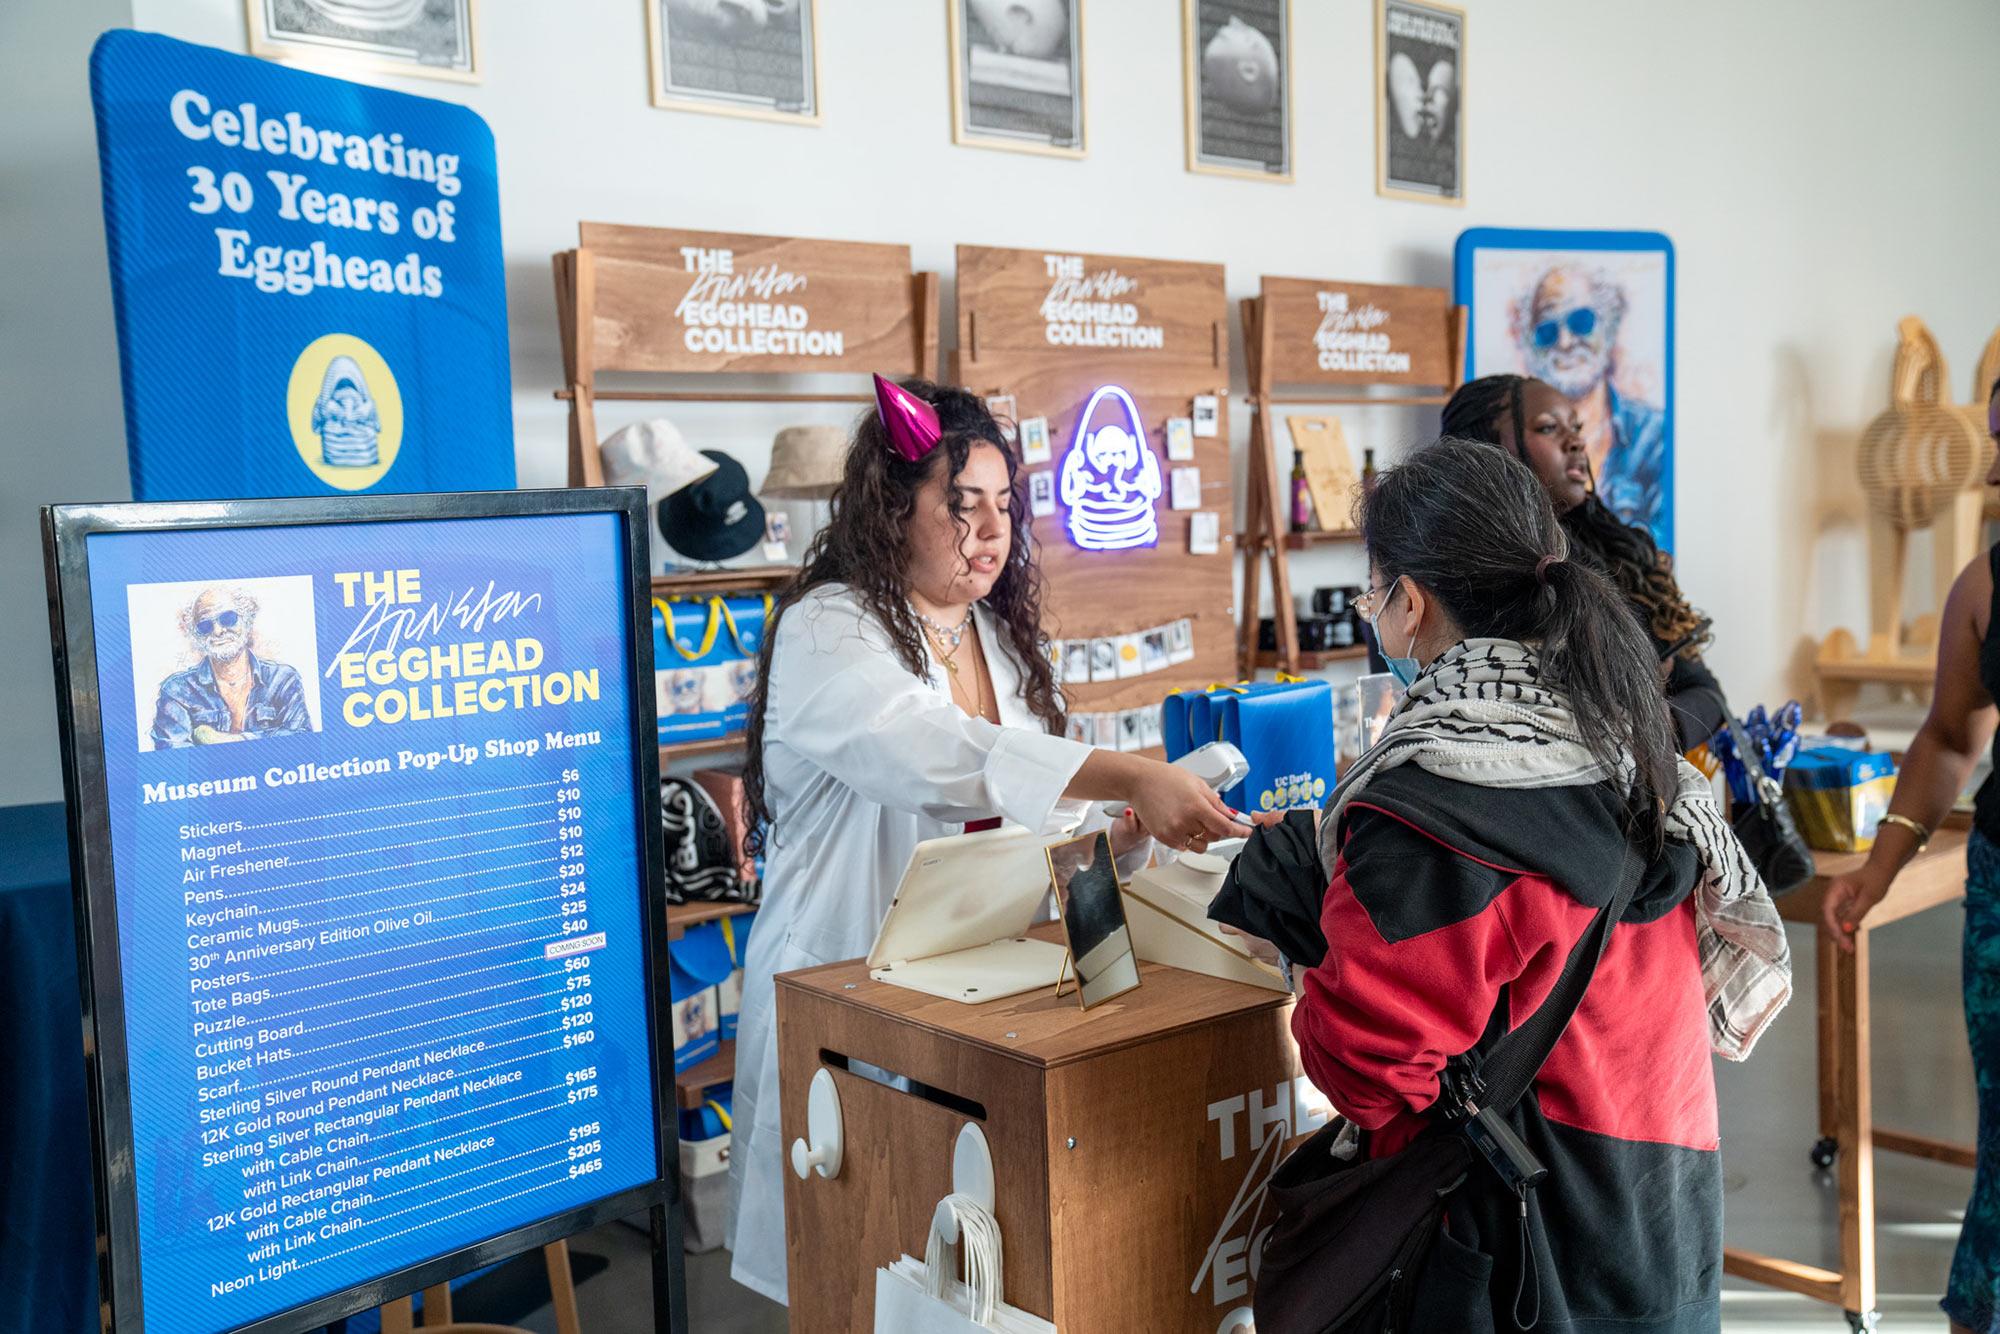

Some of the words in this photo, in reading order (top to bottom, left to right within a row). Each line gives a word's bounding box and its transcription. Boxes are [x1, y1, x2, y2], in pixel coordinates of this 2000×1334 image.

[170, 89, 461, 196] Celebrating
[187, 167, 253, 213] 30
[268, 171, 399, 235] Years
[412, 200, 456, 242] of
[214, 228, 442, 298] Eggheads
[680, 247, 733, 275] THE
[1044, 255, 1084, 277] THE
[683, 304, 807, 331] EGGHEAD
[685, 328, 842, 356] COLLECTION
[1045, 303, 1138, 324] EGGHEAD
[1046, 324, 1162, 348] COLLECTION
[334, 569, 421, 607] THE
[340, 638, 544, 688] EGGHEAD
[343, 669, 600, 727] COLLECTION
[142, 775, 257, 804] Museum
[264, 757, 391, 787] Collection
[397, 743, 478, 770] Pop-Up
[485, 739, 539, 758] Shop
[545, 730, 601, 750] Menu
[179, 821, 242, 839] Stickers
[562, 769, 579, 783] $6
[181, 840, 242, 861] Magnet
[557, 787, 580, 803] $10
[183, 869, 205, 883] Air
[210, 856, 289, 879] Freshener
[558, 806, 581, 822] $10
[184, 889, 223, 905] Pens
[559, 825, 582, 841] $10
[186, 905, 258, 927] Keychain
[560, 844, 583, 860] $12
[187, 927, 253, 949] Ceramic
[258, 919, 299, 935] Mugs
[559, 862, 585, 879] $20
[225, 936, 315, 964] Anniversary
[320, 926, 369, 944] Edition
[374, 918, 409, 933] Olive
[413, 911, 432, 926] Oil
[560, 881, 586, 898] $24
[191, 971, 250, 993] Posters
[561, 899, 587, 916] $25
[191, 998, 226, 1014] Tote
[231, 988, 270, 1006] Bags
[562, 918, 588, 935] $40
[193, 1015, 246, 1037] Puzzle
[549, 942, 580, 955] COMING
[582, 936, 604, 948] SOON
[195, 1036, 253, 1058] Cutting
[258, 1021, 303, 1043] Board
[564, 956, 590, 973] $60
[196, 1055, 252, 1080] Bucket
[256, 1048, 291, 1065] Hats
[566, 973, 591, 991] $75
[198, 1079, 239, 1102] Scarf
[560, 992, 592, 1012] $120
[199, 1099, 260, 1124] Sterling
[265, 1086, 307, 1106] Silver
[311, 1070, 358, 1094] Round
[362, 1055, 420, 1081] Pendant
[424, 1041, 485, 1065] Necklace
[561, 1011, 593, 1030] $120
[200, 1125, 229, 1145] 12K
[234, 1114, 271, 1136] Gold
[276, 1100, 324, 1125] Round
[328, 1084, 388, 1111] Pendant
[391, 1069, 454, 1094] Necklace
[562, 1029, 595, 1049] $160
[202, 1141, 263, 1167] Sterling
[268, 1128, 310, 1148] Silver
[314, 1103, 399, 1136] Rectangular
[403, 1085, 460, 1111] Pendant
[463, 1070, 522, 1095] Necklace
[241, 1158, 274, 1178] with
[279, 1145, 323, 1166] Cable
[326, 1133, 369, 1153] Chain
[565, 1066, 597, 1086] $165
[243, 1179, 276, 1199] with
[280, 1168, 312, 1188] Link
[316, 1156, 358, 1177] Chain
[567, 1084, 598, 1105] $175
[1207, 1075, 1328, 1160] THE
[206, 1211, 235, 1232] 12K
[240, 1199, 277, 1221] Gold
[281, 1173, 369, 1209] Rectangular
[373, 1153, 431, 1181] Pendant
[433, 1136, 495, 1163] Necklace
[245, 1221, 279, 1242] with
[283, 1207, 327, 1229] Cable
[331, 1193, 373, 1214] Chain
[568, 1121, 600, 1142] $195
[247, 1242, 280, 1263] with
[284, 1231, 316, 1251] Link
[319, 1217, 363, 1239] Chain
[567, 1139, 601, 1161] $205
[211, 1274, 254, 1297] Neon
[258, 1258, 298, 1281] Light
[568, 1157, 602, 1180] $465
